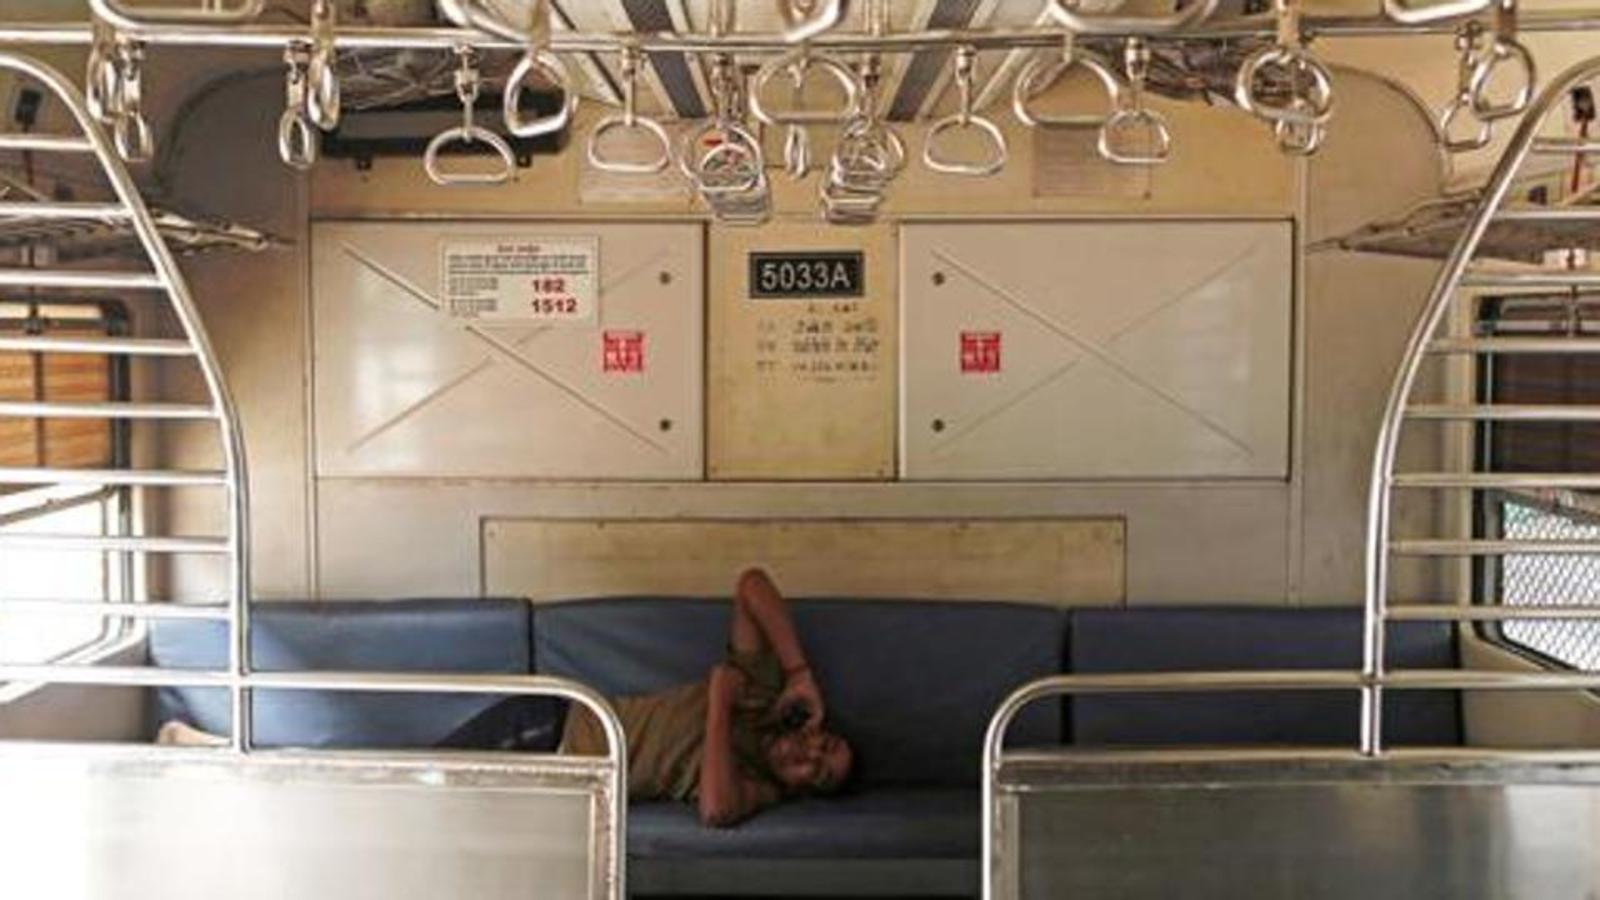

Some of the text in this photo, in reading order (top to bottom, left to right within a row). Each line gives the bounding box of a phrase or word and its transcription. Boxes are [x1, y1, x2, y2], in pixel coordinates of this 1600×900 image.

[761, 261, 850, 290] 5033A
[532, 278, 566, 293] 182
[532, 298, 578, 313] 1512
